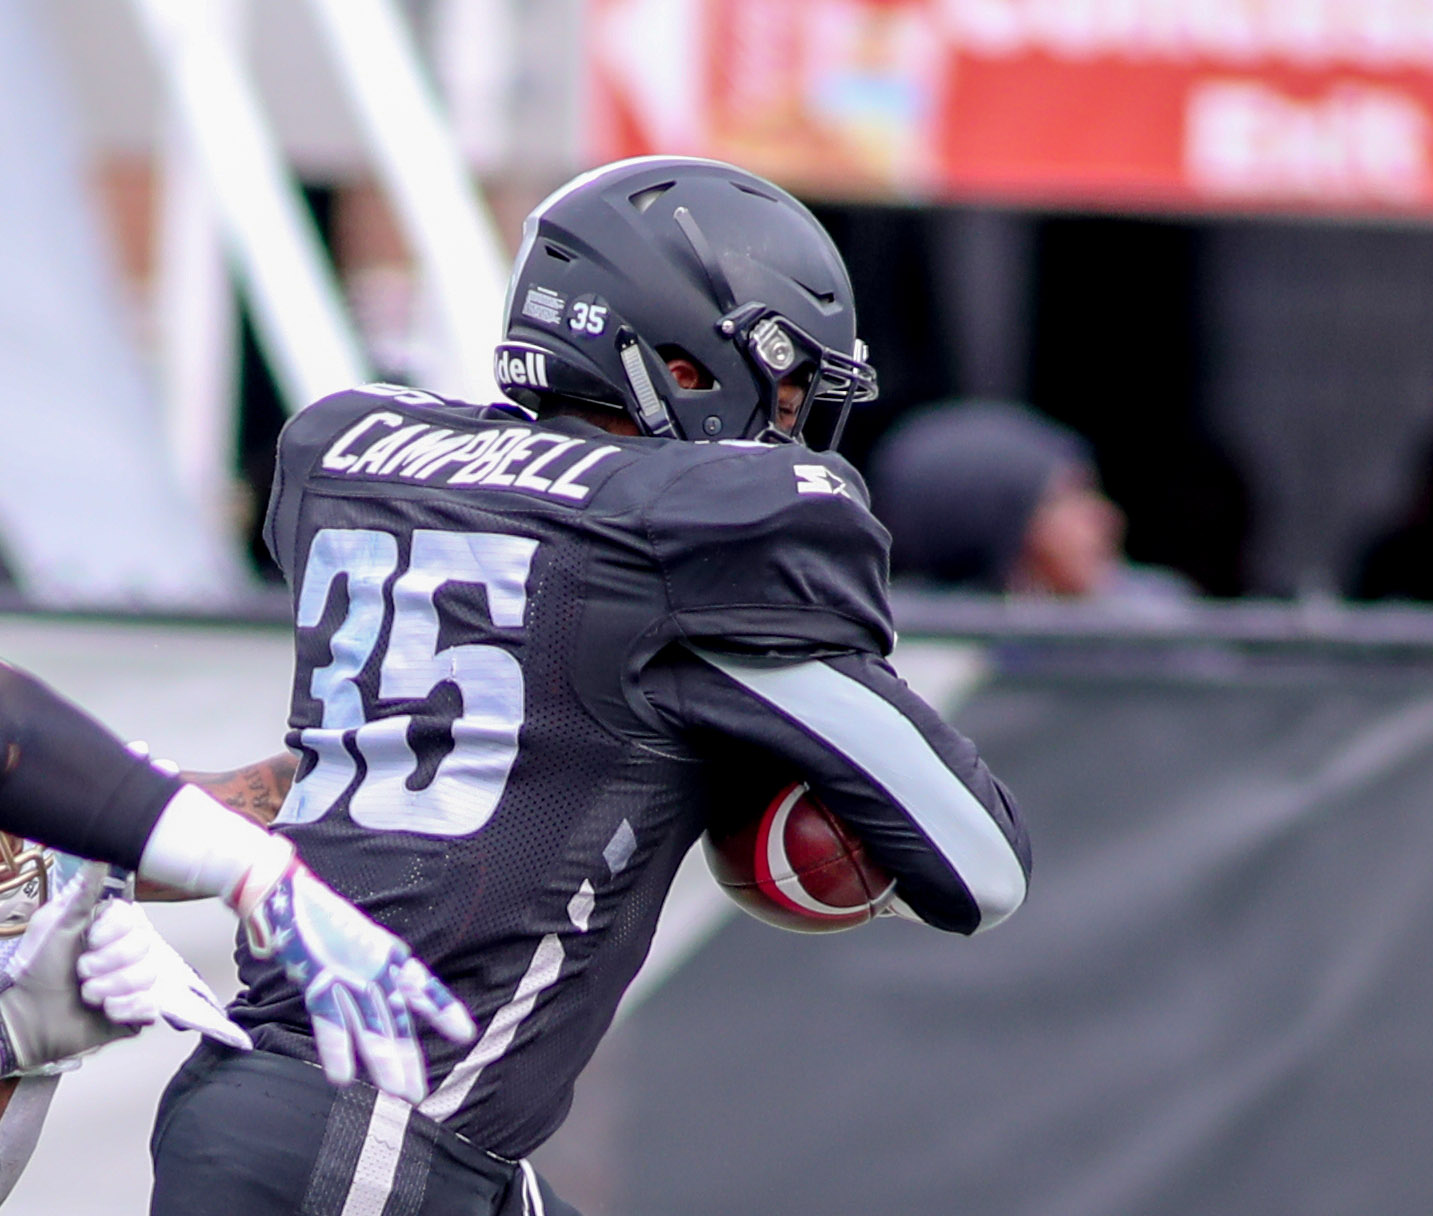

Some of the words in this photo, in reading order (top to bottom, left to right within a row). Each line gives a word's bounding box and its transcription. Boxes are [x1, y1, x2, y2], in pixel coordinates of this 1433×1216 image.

[570, 302, 607, 335] 35
[496, 349, 549, 388] dell
[322, 411, 622, 500] CAMPBELL
[269, 527, 541, 838] 35
